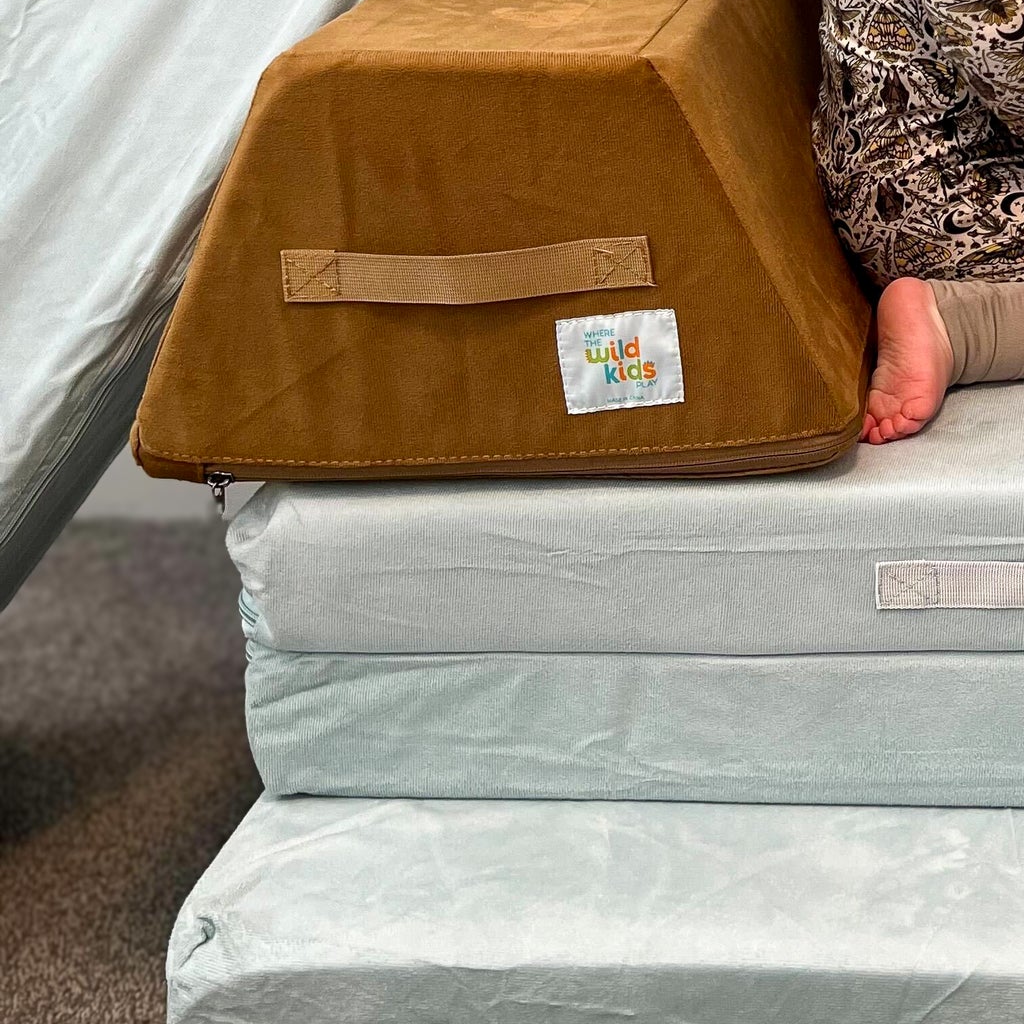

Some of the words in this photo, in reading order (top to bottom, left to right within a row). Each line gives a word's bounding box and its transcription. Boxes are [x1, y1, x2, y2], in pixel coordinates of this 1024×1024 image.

[583, 328, 615, 339] WHERE
[584, 339, 602, 347] THE
[584, 336, 640, 364] wild
[603, 359, 657, 384] kids
[636, 379, 658, 388] PLAY
